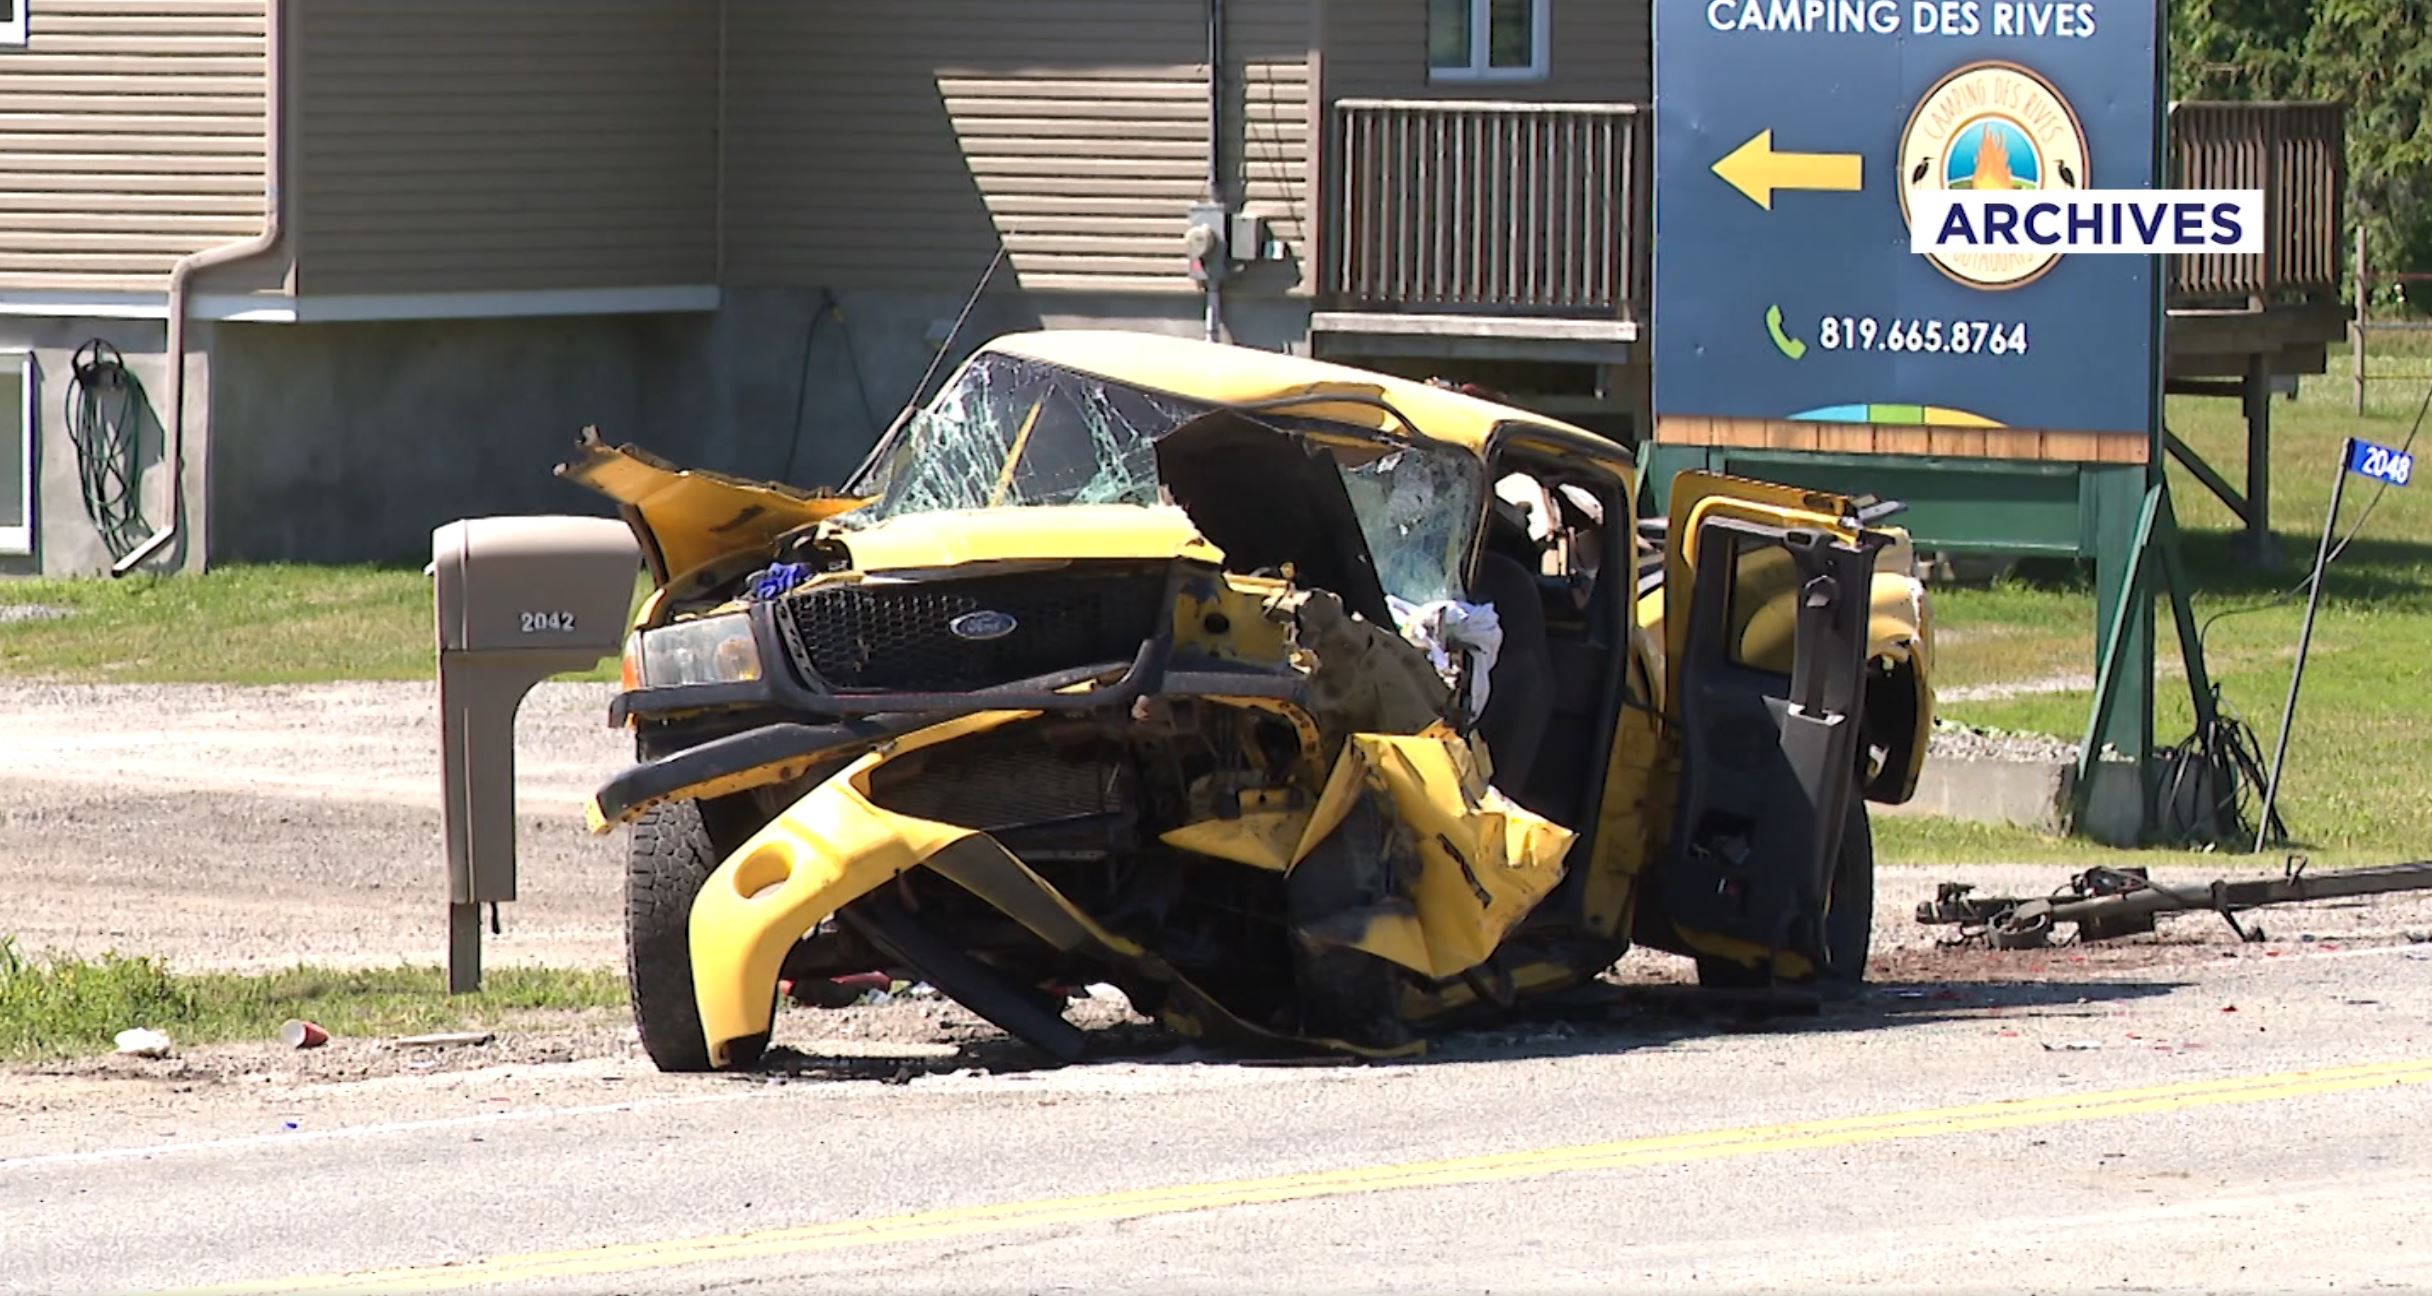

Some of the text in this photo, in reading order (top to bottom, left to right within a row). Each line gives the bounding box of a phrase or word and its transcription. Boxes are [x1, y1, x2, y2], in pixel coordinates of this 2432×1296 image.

[1706, 0, 2096, 37] CAMPING DES RIVES
[1923, 77, 2065, 143] CAMPING DES RIVES
[1820, 316, 2028, 355] 819.665.8764
[2361, 446, 2411, 483] 2048
[521, 611, 575, 632] 2042
